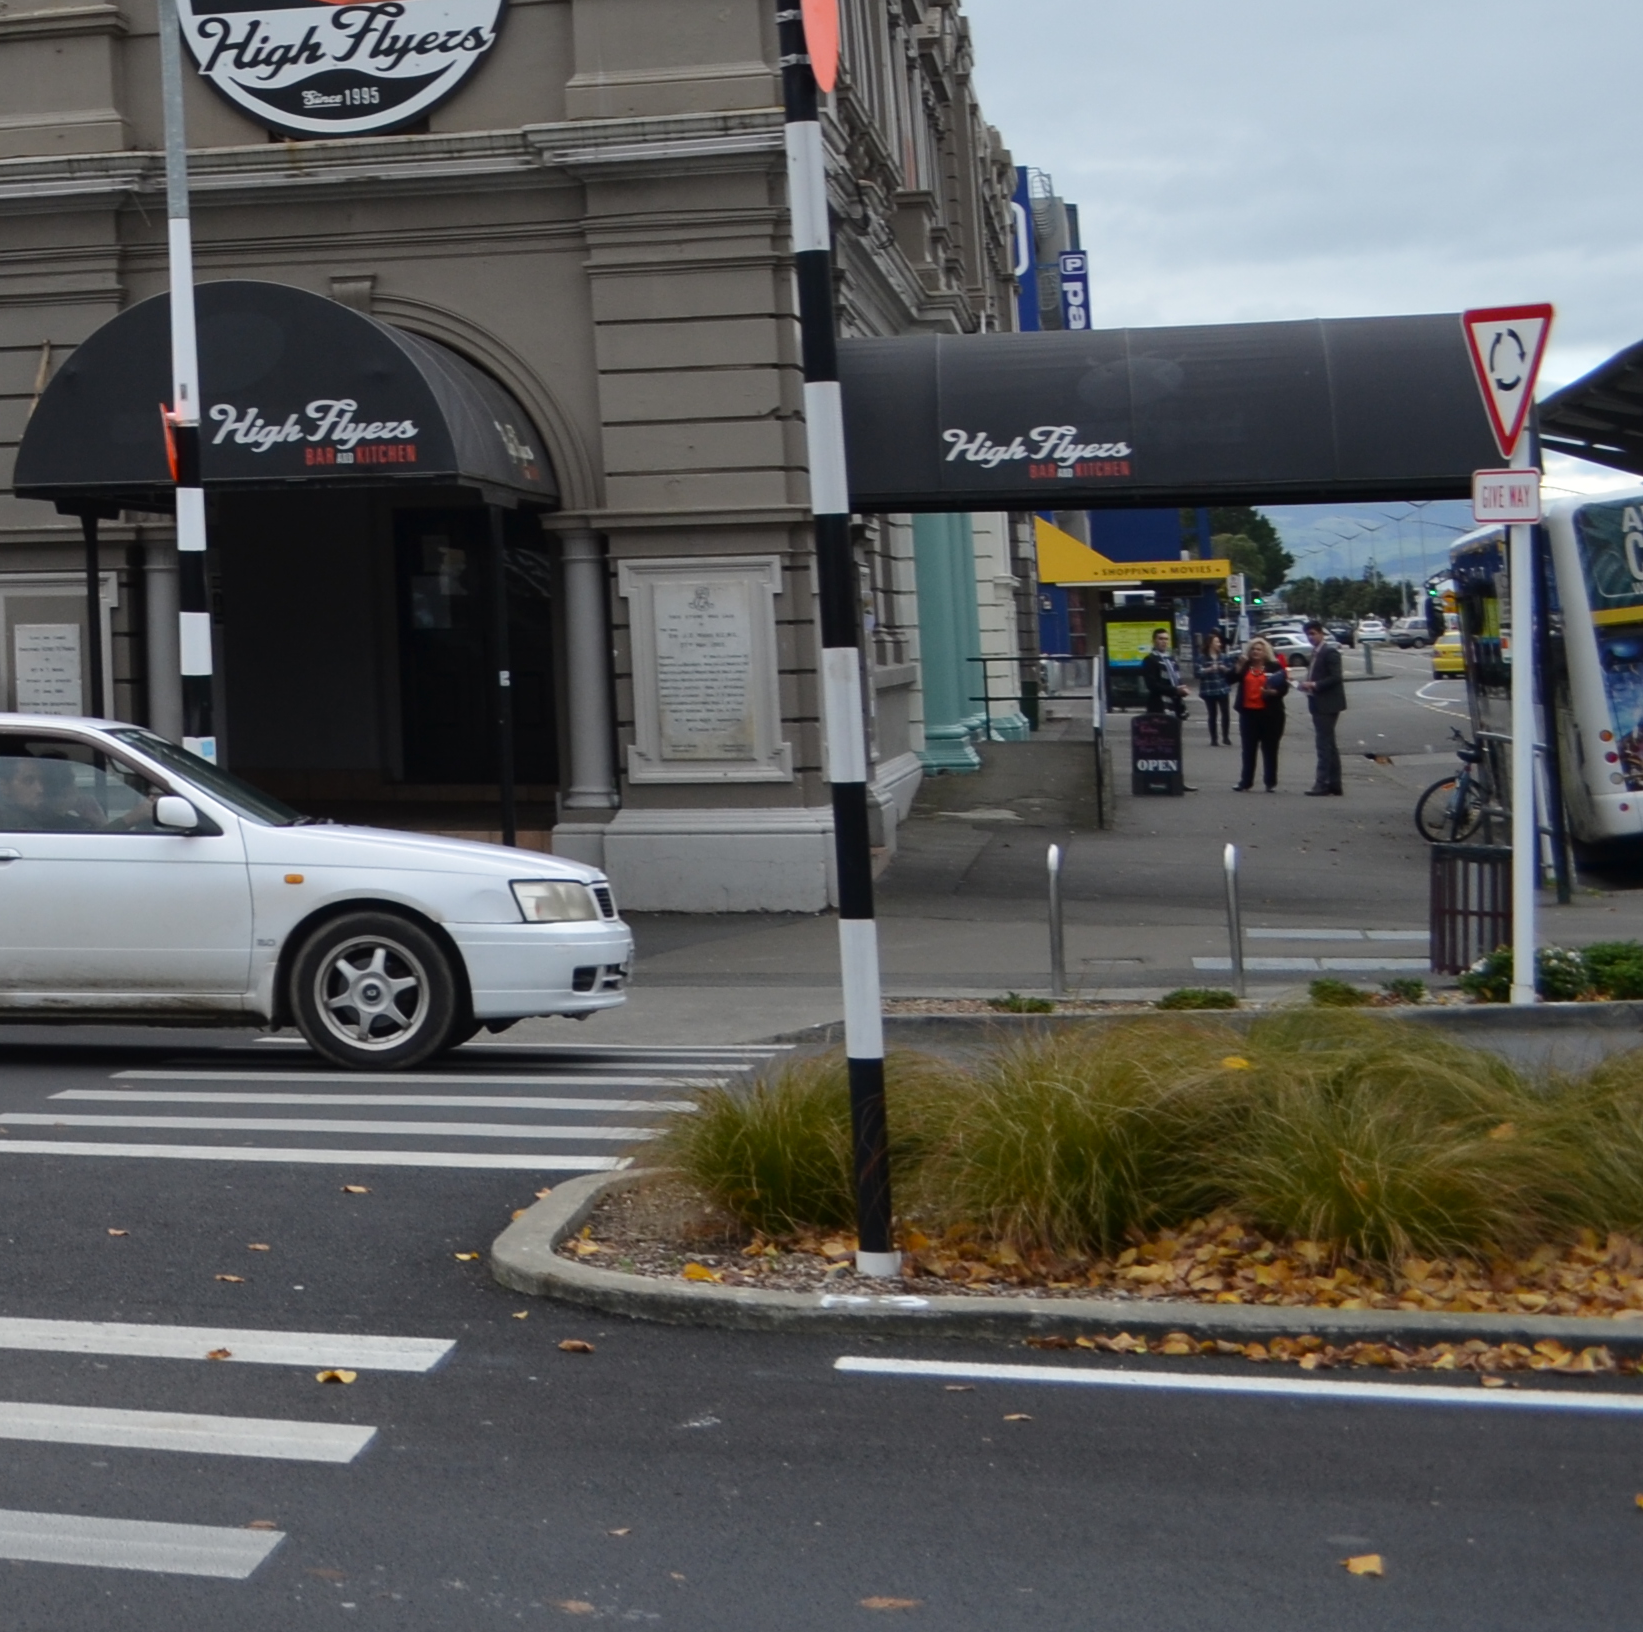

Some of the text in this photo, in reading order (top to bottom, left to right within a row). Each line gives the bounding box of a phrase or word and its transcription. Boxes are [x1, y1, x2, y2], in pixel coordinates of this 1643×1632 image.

[197, 2, 494, 81] High Flyers
[302, 86, 381, 106] Since 1995
[209, 398, 420, 453] High Flyers
[304, 446, 336, 466] BAR
[355, 444, 418, 464] KITCHEN
[942, 425, 1133, 469] High Flyers
[1028, 463, 1057, 479] BAR
[1074, 460, 1131, 477] KITCHEN
[1482, 484, 1531, 509] GIVE WAY
[1102, 565, 1212, 576] SHOPPING MOVIES
[1136, 759, 1178, 772] OPEN
